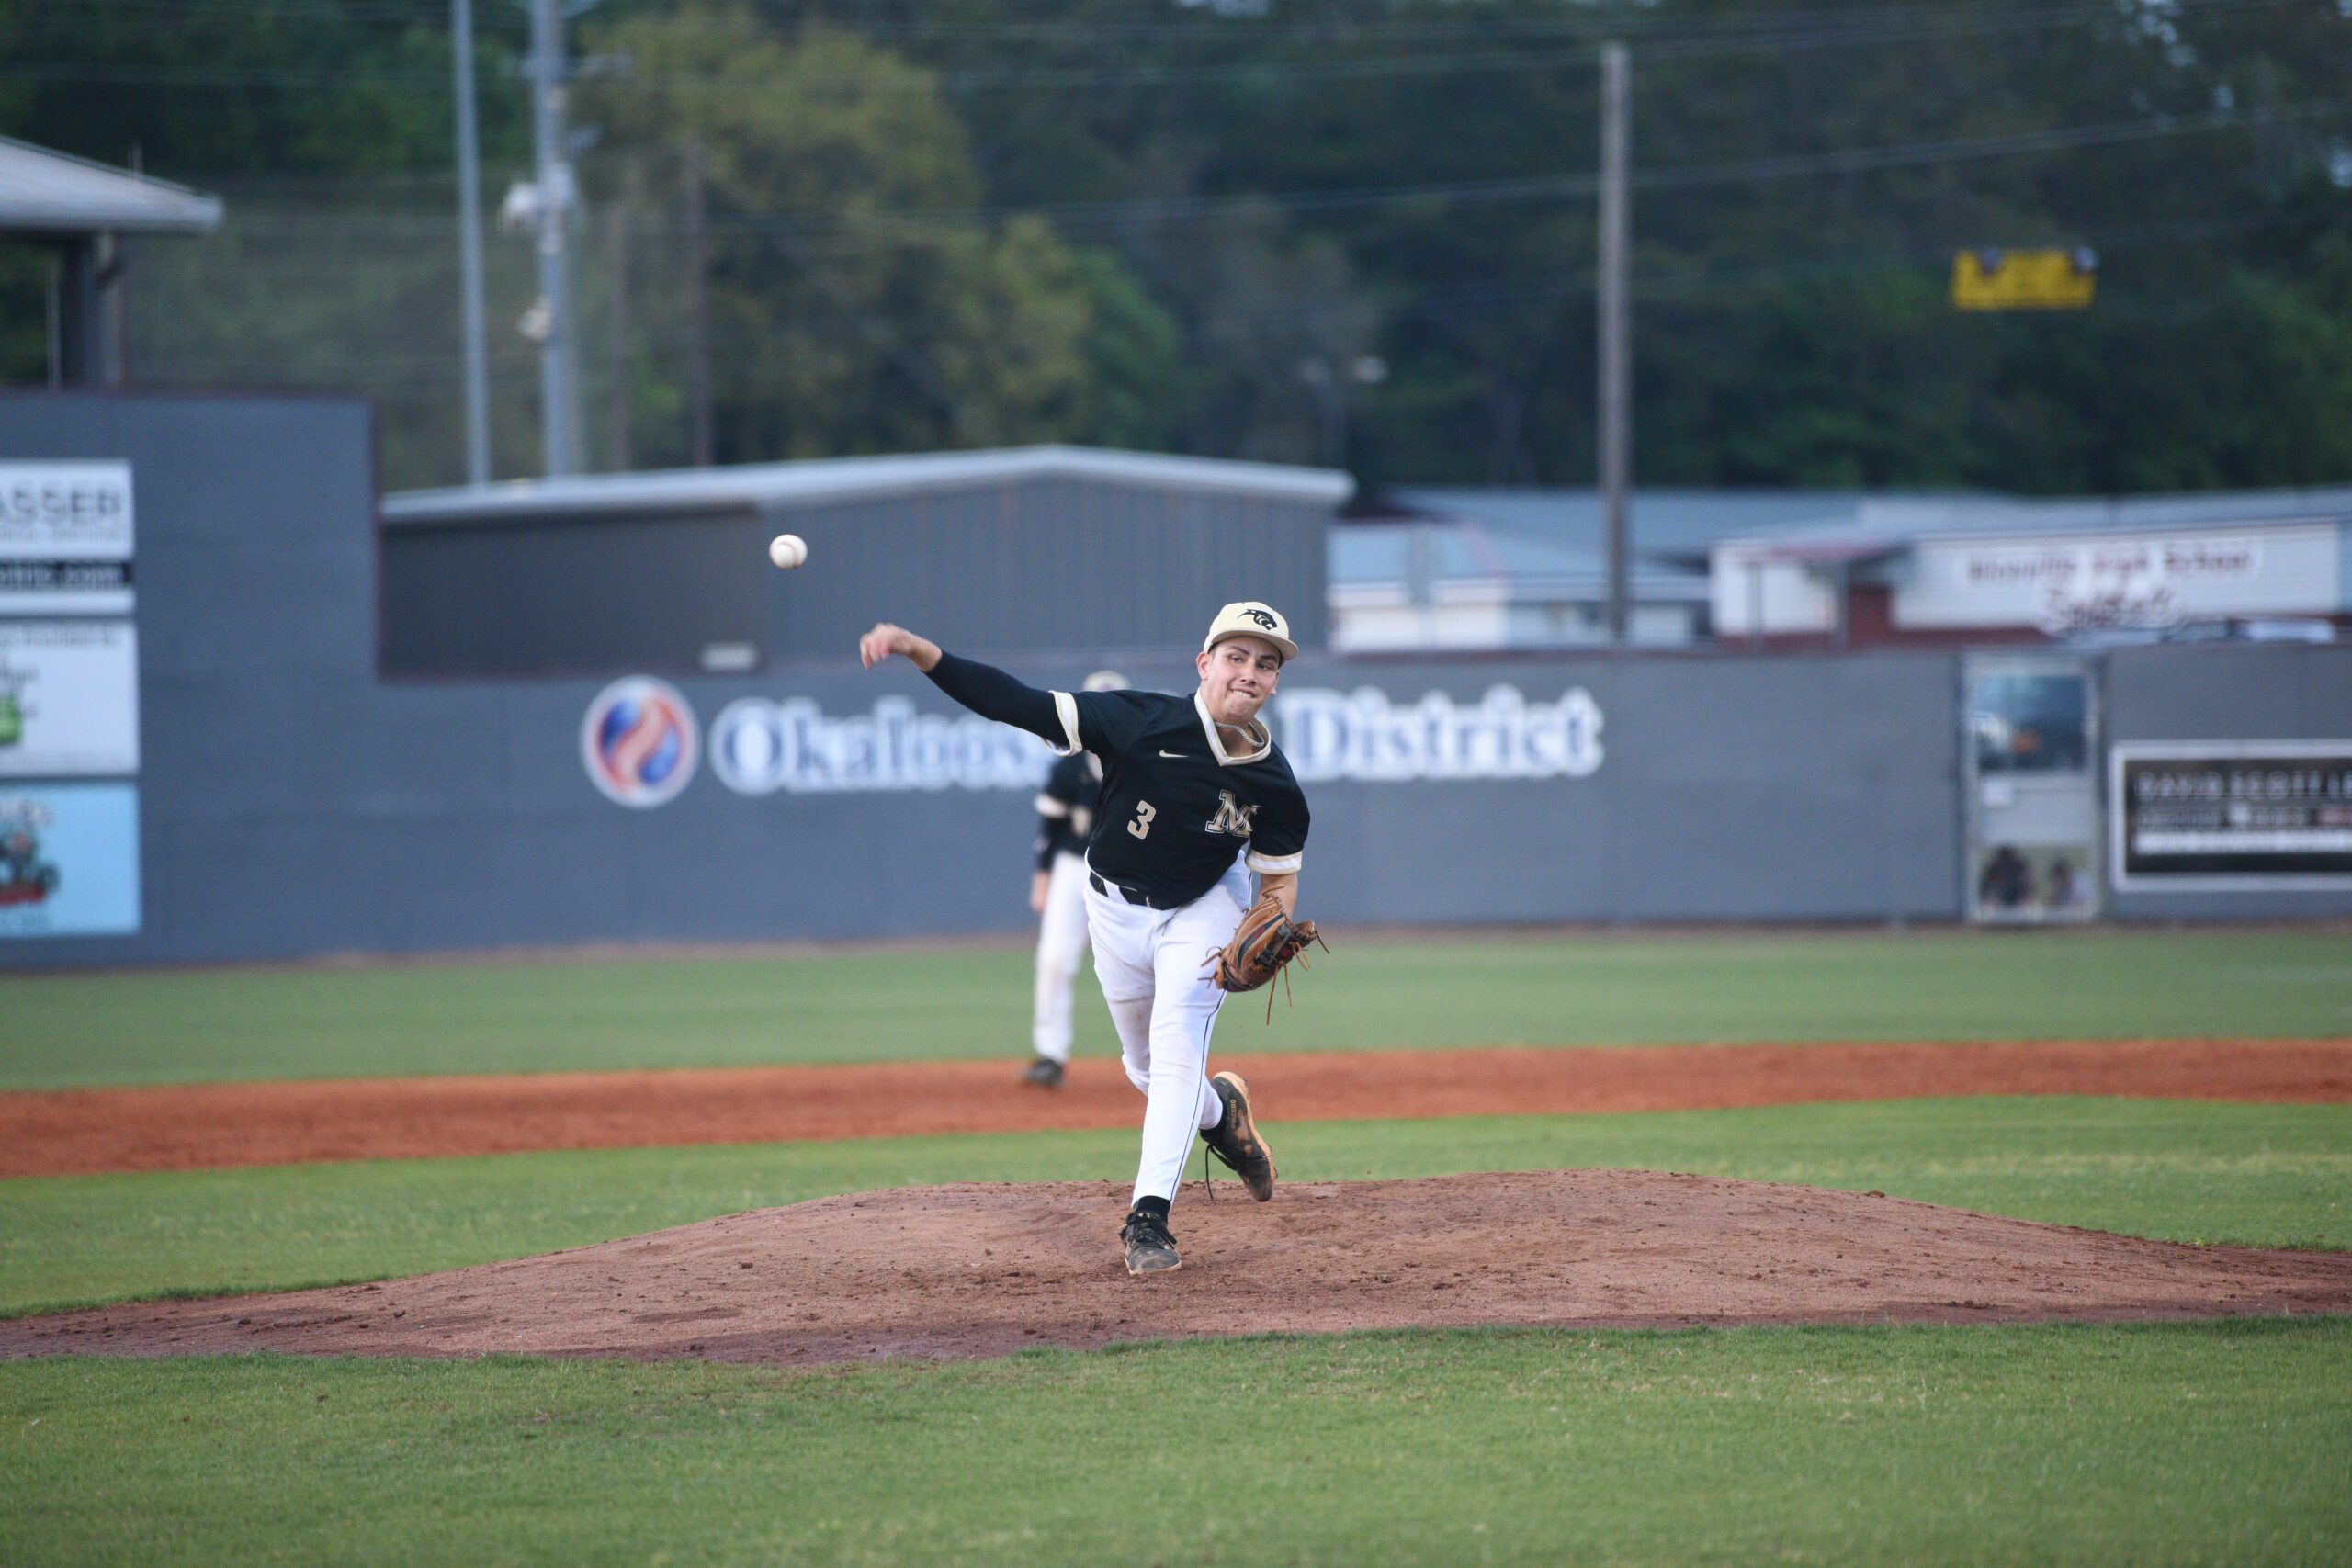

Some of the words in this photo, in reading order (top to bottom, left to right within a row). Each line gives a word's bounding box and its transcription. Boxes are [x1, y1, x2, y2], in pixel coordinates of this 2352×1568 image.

[710, 697, 1057, 794] Okaloos
[1279, 687, 1604, 781] District
[2229, 769, 2323, 800] SCOTT
[1127, 800, 1157, 840] 3
